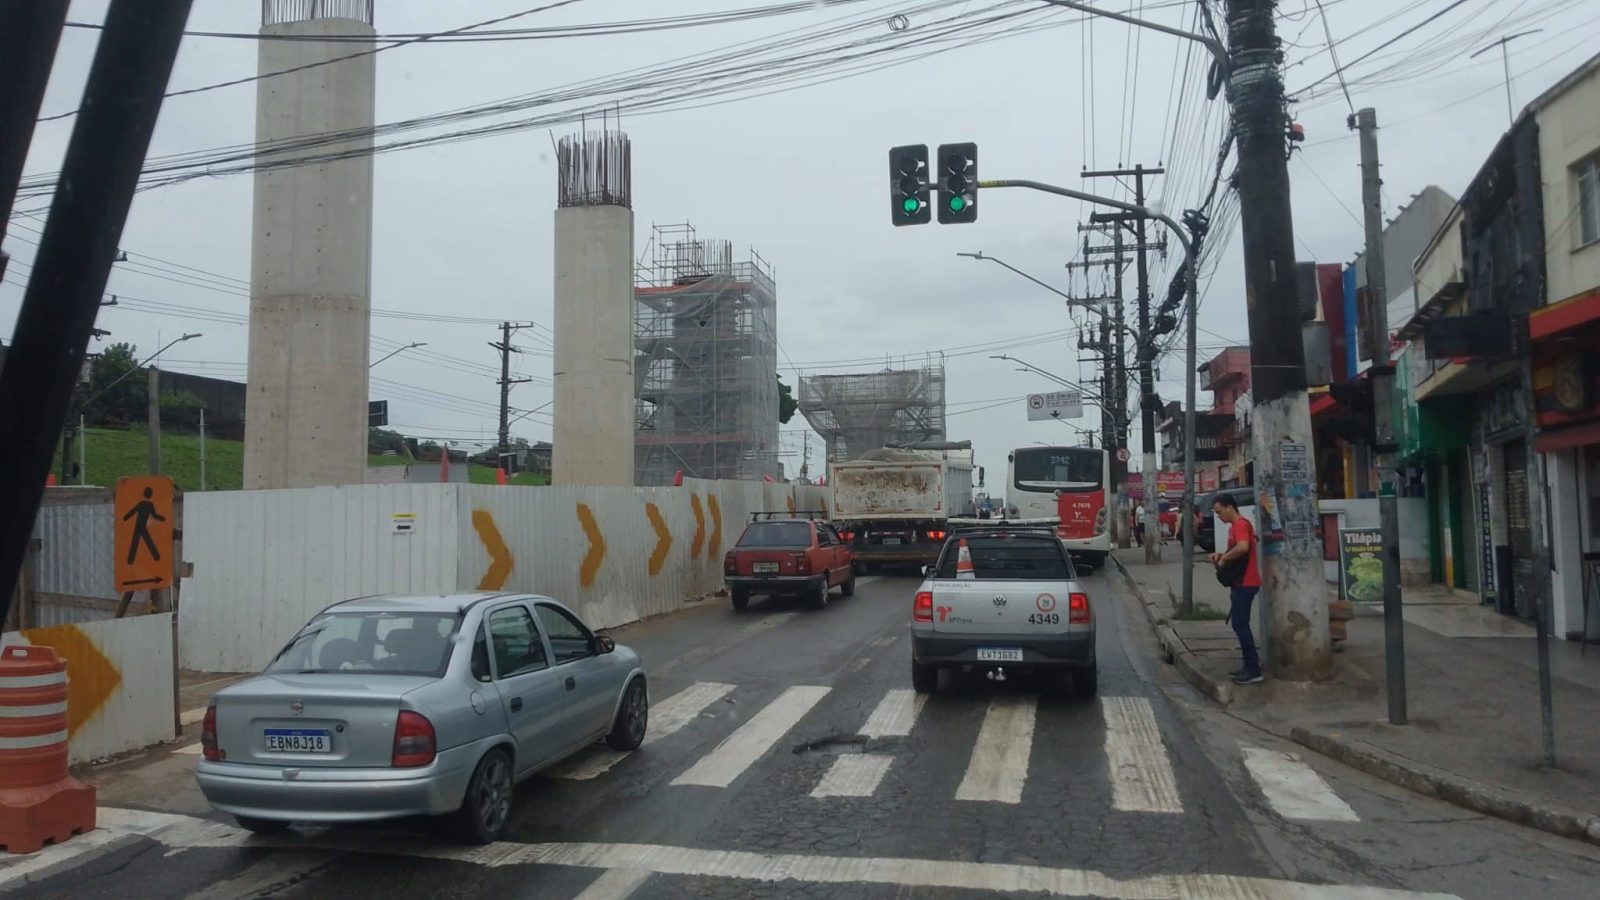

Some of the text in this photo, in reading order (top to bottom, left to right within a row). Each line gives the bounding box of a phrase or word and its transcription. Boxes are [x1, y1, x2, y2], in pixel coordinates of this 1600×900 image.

[1195, 437, 1217, 449] Auto
[1344, 532, 1382, 546] Tilápia
[1028, 613, 1060, 625] 4349
[270, 735, 324, 750] EBN8J18
